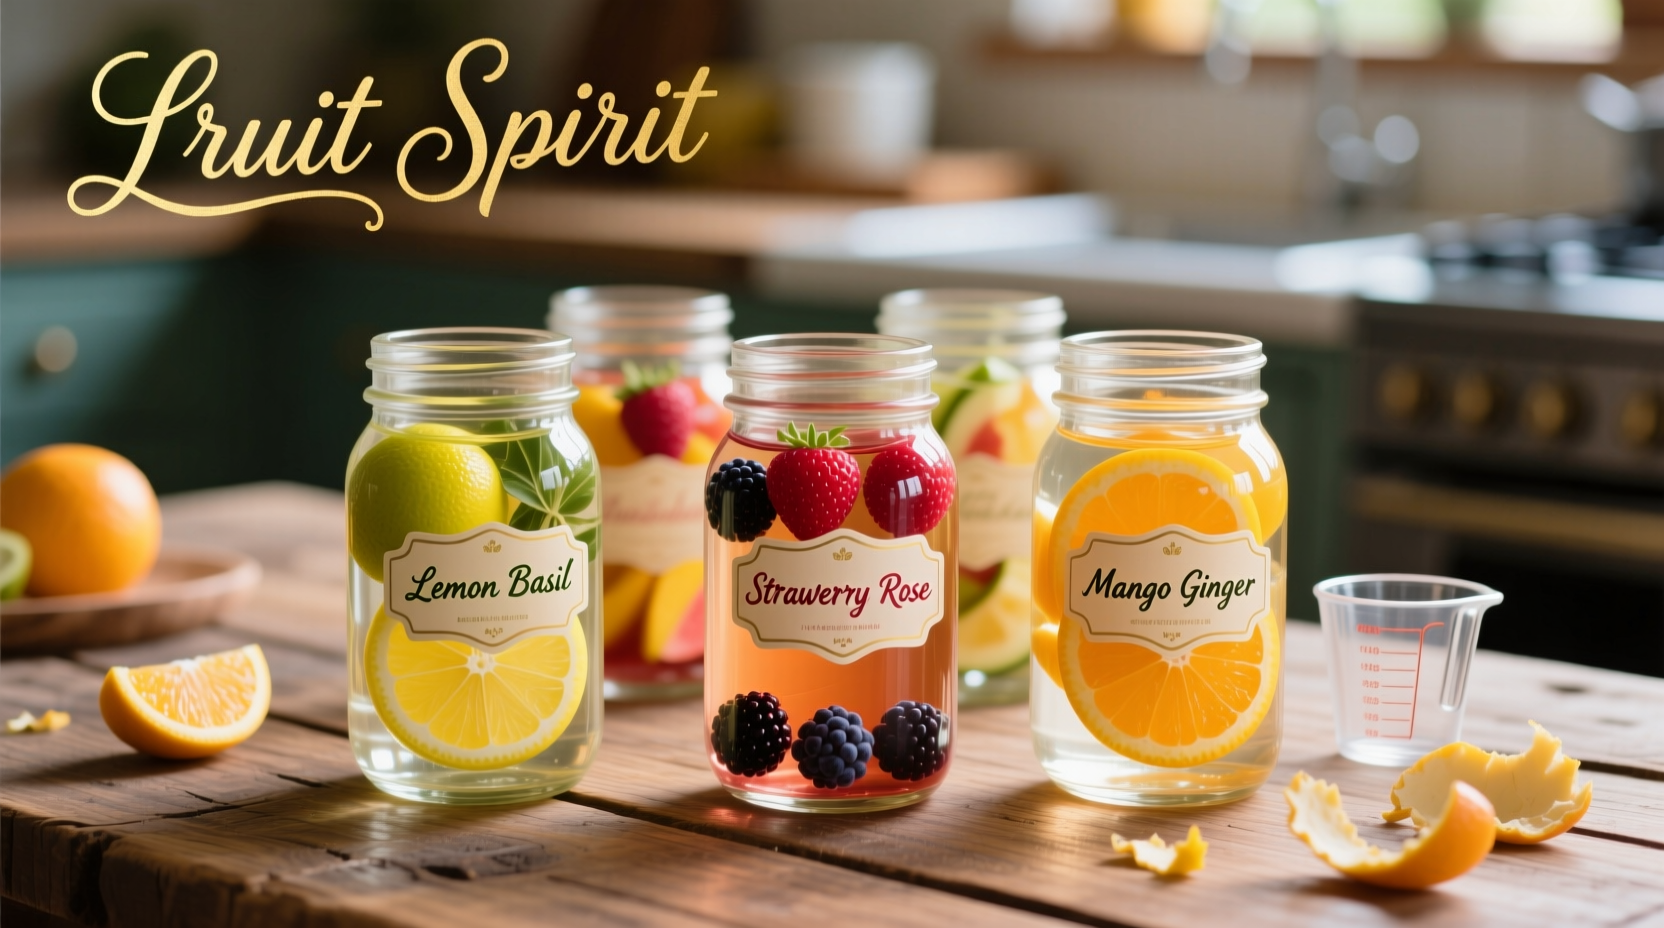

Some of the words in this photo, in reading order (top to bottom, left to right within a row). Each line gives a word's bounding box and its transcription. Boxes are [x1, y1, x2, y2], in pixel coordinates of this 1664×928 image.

[405, 566, 500, 602] Lemon
[508, 558, 574, 597] Basil
[745, 572, 870, 618] Strawerry
[879, 572, 932, 608] Rose
[1082, 568, 1171, 612] Mango
[1180, 569, 1255, 610] Ginger
